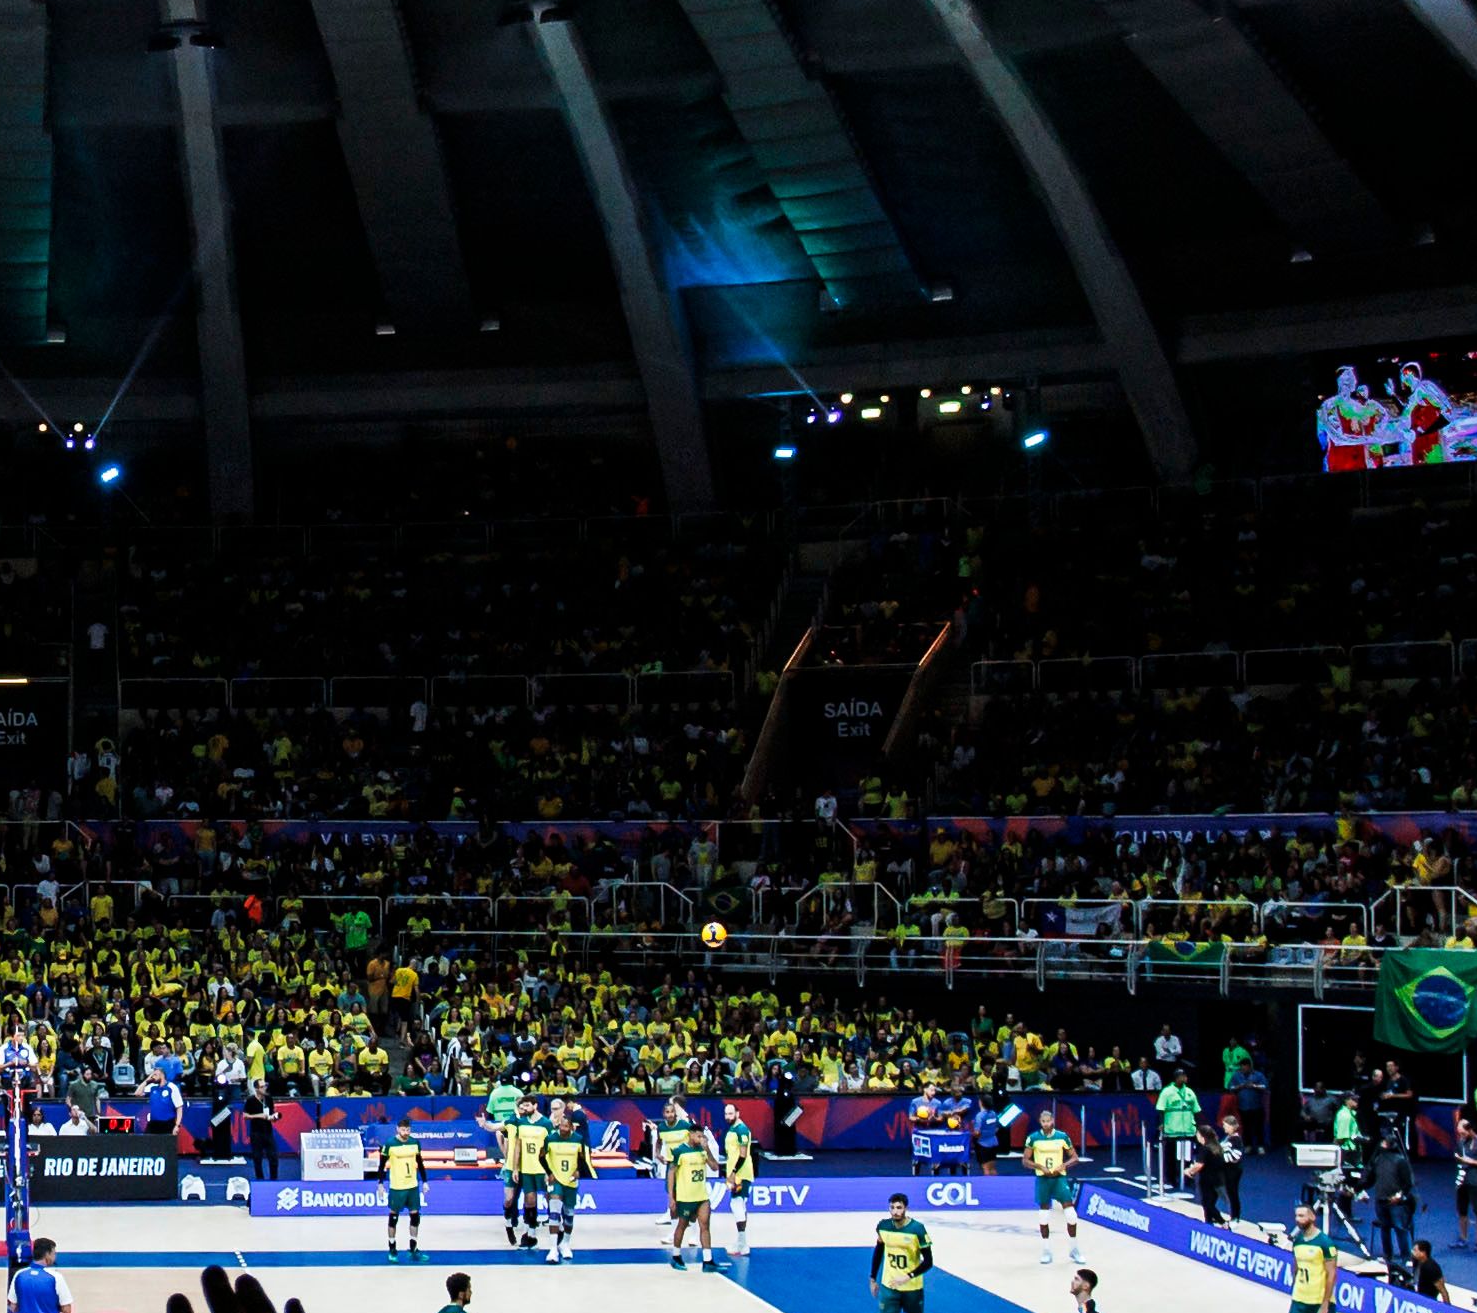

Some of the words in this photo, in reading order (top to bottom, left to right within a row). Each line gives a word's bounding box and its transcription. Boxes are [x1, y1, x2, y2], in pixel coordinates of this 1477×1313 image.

[824, 697, 883, 719] SAÍDA
[838, 721, 871, 738] Exit
[44, 1157, 71, 1177] RIO
[77, 1157, 97, 1177] DE
[98, 1157, 165, 1177] JANEIRO
[302, 1191, 354, 1208] BANCO
[355, 1191, 376, 1208] DO
[747, 1186, 809, 1206] BTV
[926, 1183, 979, 1206] GOL
[888, 1254, 908, 1270] 20
[1189, 1230, 1235, 1266] WATCH
[1236, 1247, 1285, 1283] EVERY
[1338, 1283, 1364, 1311] ON
